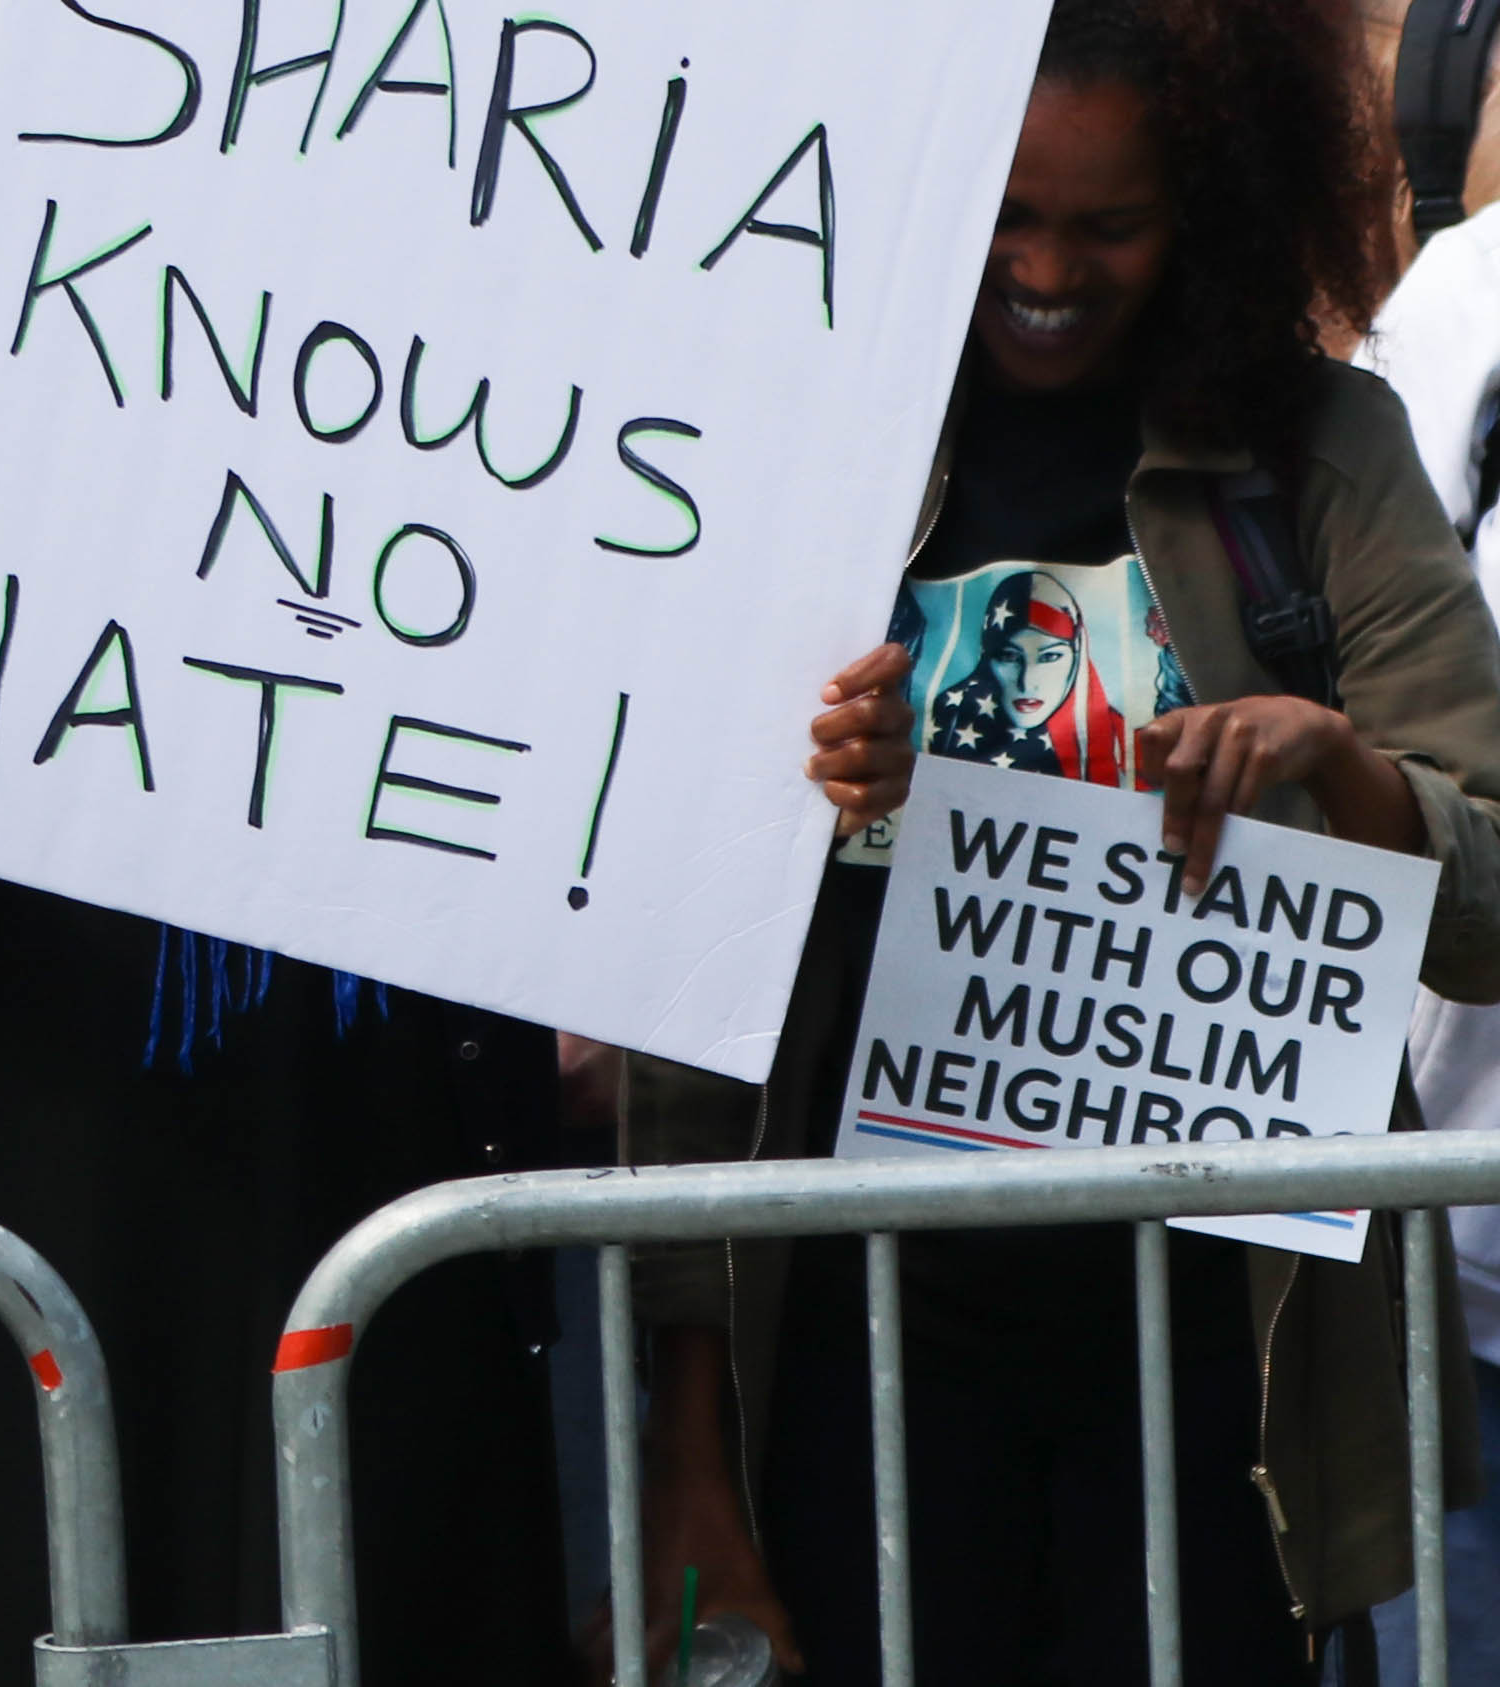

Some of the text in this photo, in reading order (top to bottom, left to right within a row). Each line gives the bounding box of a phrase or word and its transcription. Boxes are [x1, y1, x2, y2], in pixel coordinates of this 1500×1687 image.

[12, 199, 704, 558] KNOWS
[195, 469, 477, 646] NO
[950, 809, 1384, 953] WE STAND
[934, 886, 1367, 1033] WITH OUR
[954, 974, 1302, 1103] MUSLIM
